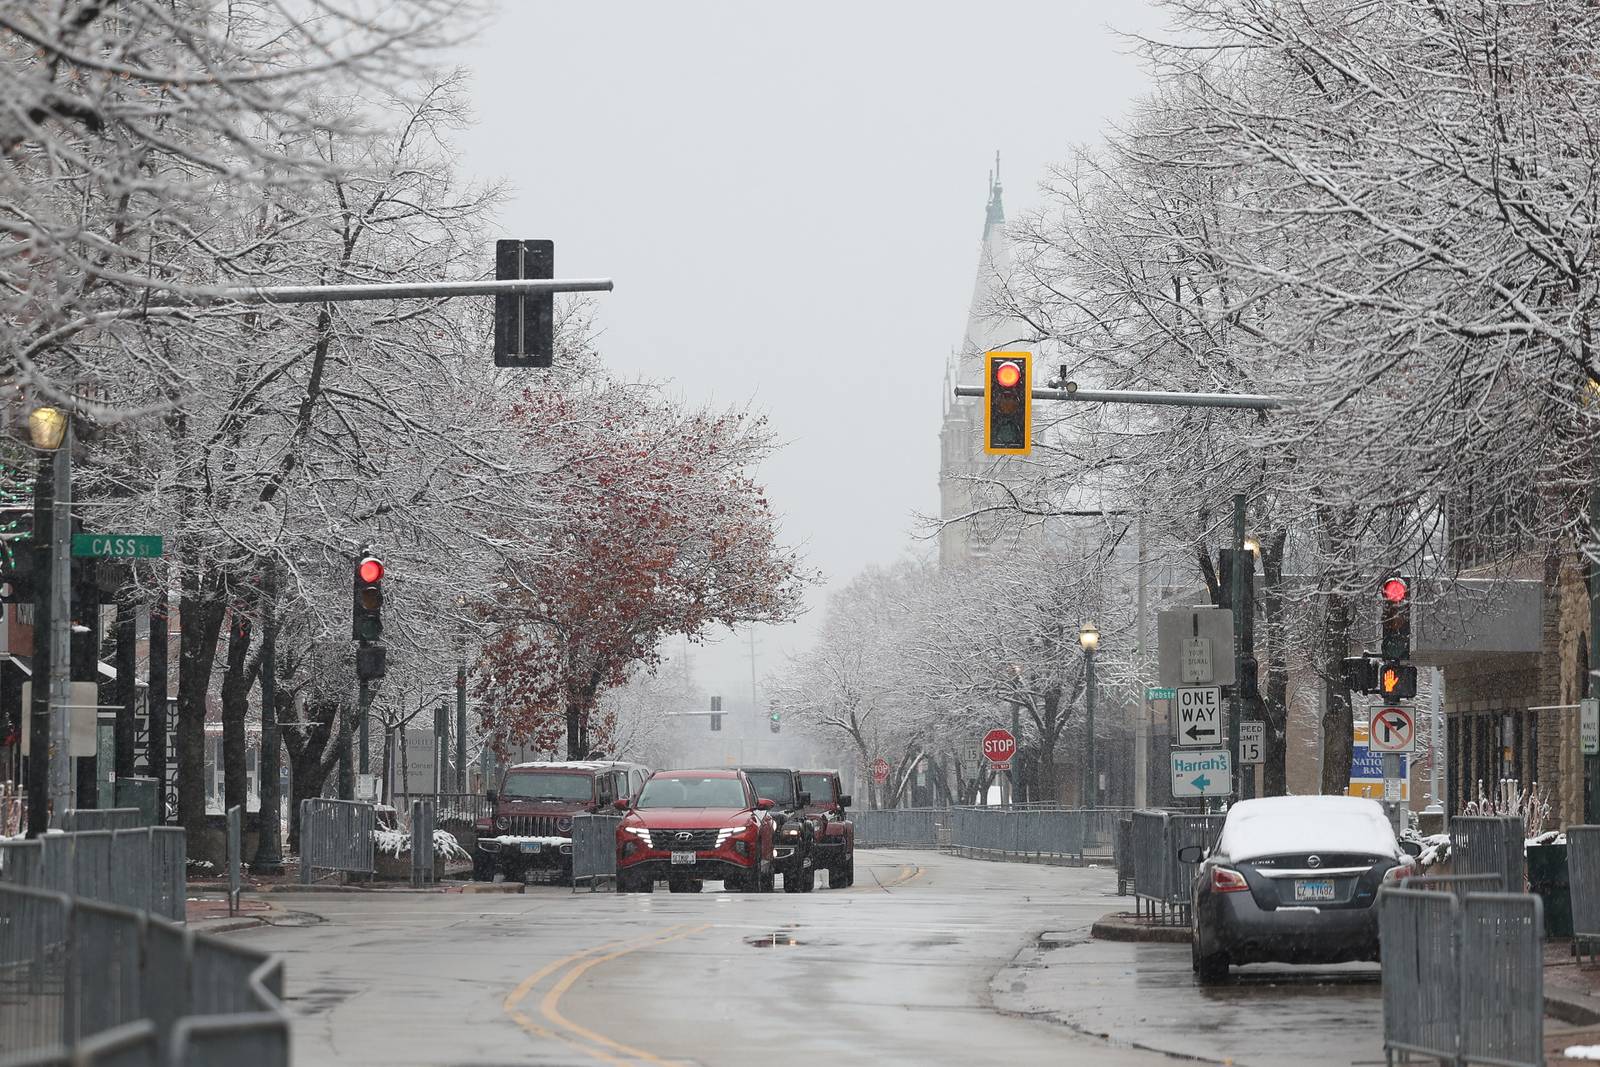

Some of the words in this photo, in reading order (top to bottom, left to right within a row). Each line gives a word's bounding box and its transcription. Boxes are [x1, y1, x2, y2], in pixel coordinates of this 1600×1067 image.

[92, 539, 136, 555] CASS
[1182, 691, 1215, 705] ONE
[1182, 707, 1216, 722] WAY
[985, 739, 1013, 753] STOP
[1243, 744, 1259, 760] 15
[968, 750, 977, 759] 15
[875, 763, 888, 774] TOP
[1353, 758, 1383, 766] NATIO
